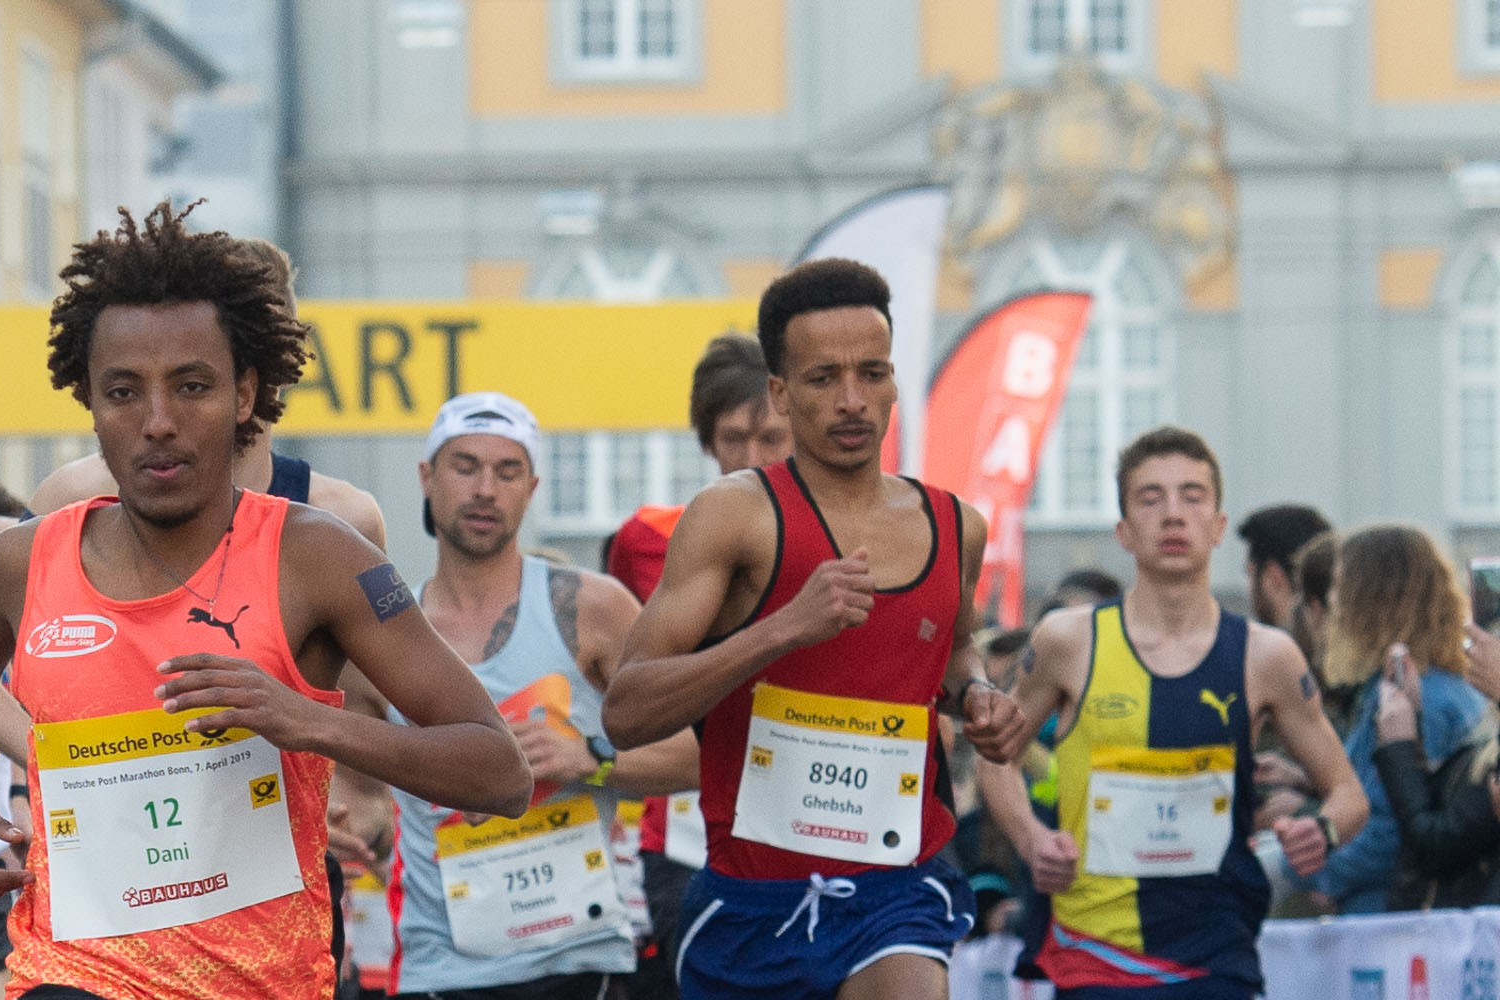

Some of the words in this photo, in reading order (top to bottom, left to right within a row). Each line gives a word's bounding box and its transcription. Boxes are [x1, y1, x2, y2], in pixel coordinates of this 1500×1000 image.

[276, 319, 478, 413] ART
[784, 708, 846, 728] Deutsche
[849, 716, 877, 731] Post
[68, 736, 148, 760] Deutsche
[152, 729, 191, 748] Post
[63, 778, 96, 790] Deutsche
[98, 777, 118, 786] Post
[120, 767, 165, 783] Marathon
[167, 765, 193, 775] Bonn,
[195, 763, 203, 771] 7.
[205, 758, 228, 771] April
[230, 750, 251, 764] 2019
[809, 762, 868, 790] 8940
[144, 797, 183, 829] 12
[802, 794, 864, 816] Ghebsha
[803, 824, 869, 844] BAUHAUS
[146, 842, 190, 865] Dani
[140, 873, 228, 905] BAUHAUS
[503, 862, 554, 893] 7519
